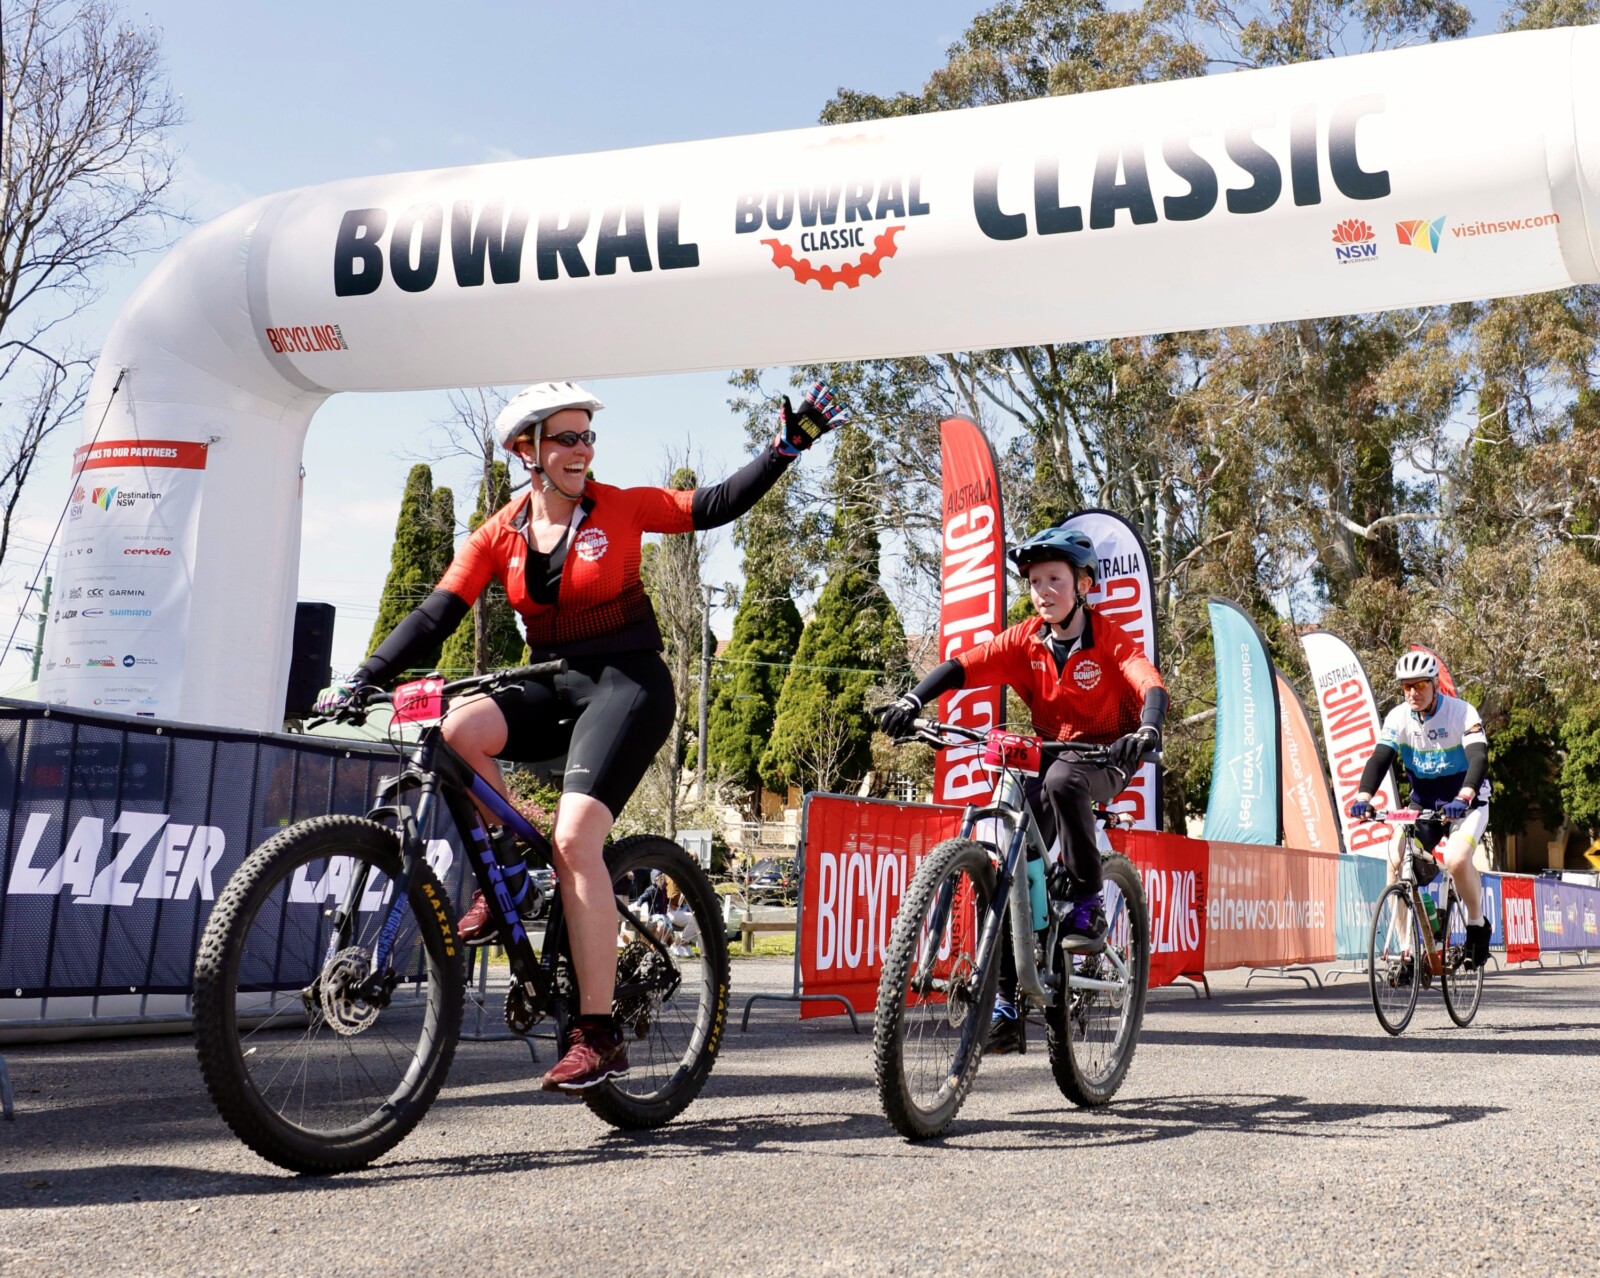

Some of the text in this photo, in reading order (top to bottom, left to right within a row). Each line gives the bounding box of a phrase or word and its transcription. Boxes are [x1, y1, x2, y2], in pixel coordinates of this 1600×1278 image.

[973, 94, 1391, 241] CLASSIC
[735, 172, 931, 234] BOWRAL
[801, 227, 865, 252] CLASSIC
[1452, 213, 1561, 238] visitnsw.com
[334, 199, 700, 297] BOWRAL
[1335, 243, 1377, 260] NSW
[265, 324, 342, 353] BICYCLING
[103, 448, 112, 458] TO
[112, 447, 129, 458] OUR
[131, 447, 178, 458] PARTNERS
[116, 499, 136, 507] NSW
[117, 491, 162, 500] Destination
[123, 546, 172, 557] cervélo
[1098, 552, 1141, 580] TRALIA
[108, 589, 145, 597] GARMIN
[109, 609, 152, 617] SHIMANO
[1073, 667, 1102, 680] BOWRAL
[1319, 662, 1359, 689] AUSTRALIA
[7, 811, 226, 906] LAZER
[286, 838, 454, 912] LAZR
[470, 825, 528, 946] TREK
[1195, 871, 1206, 921] TRALIA
[1205, 887, 1326, 931] eelnewsouthwales
[422, 883, 456, 957] MAXXIS
[951, 876, 963, 959] AUSTRA
[376, 907, 404, 966] OCKSHOX
[707, 983, 726, 1054] MAXXIS
